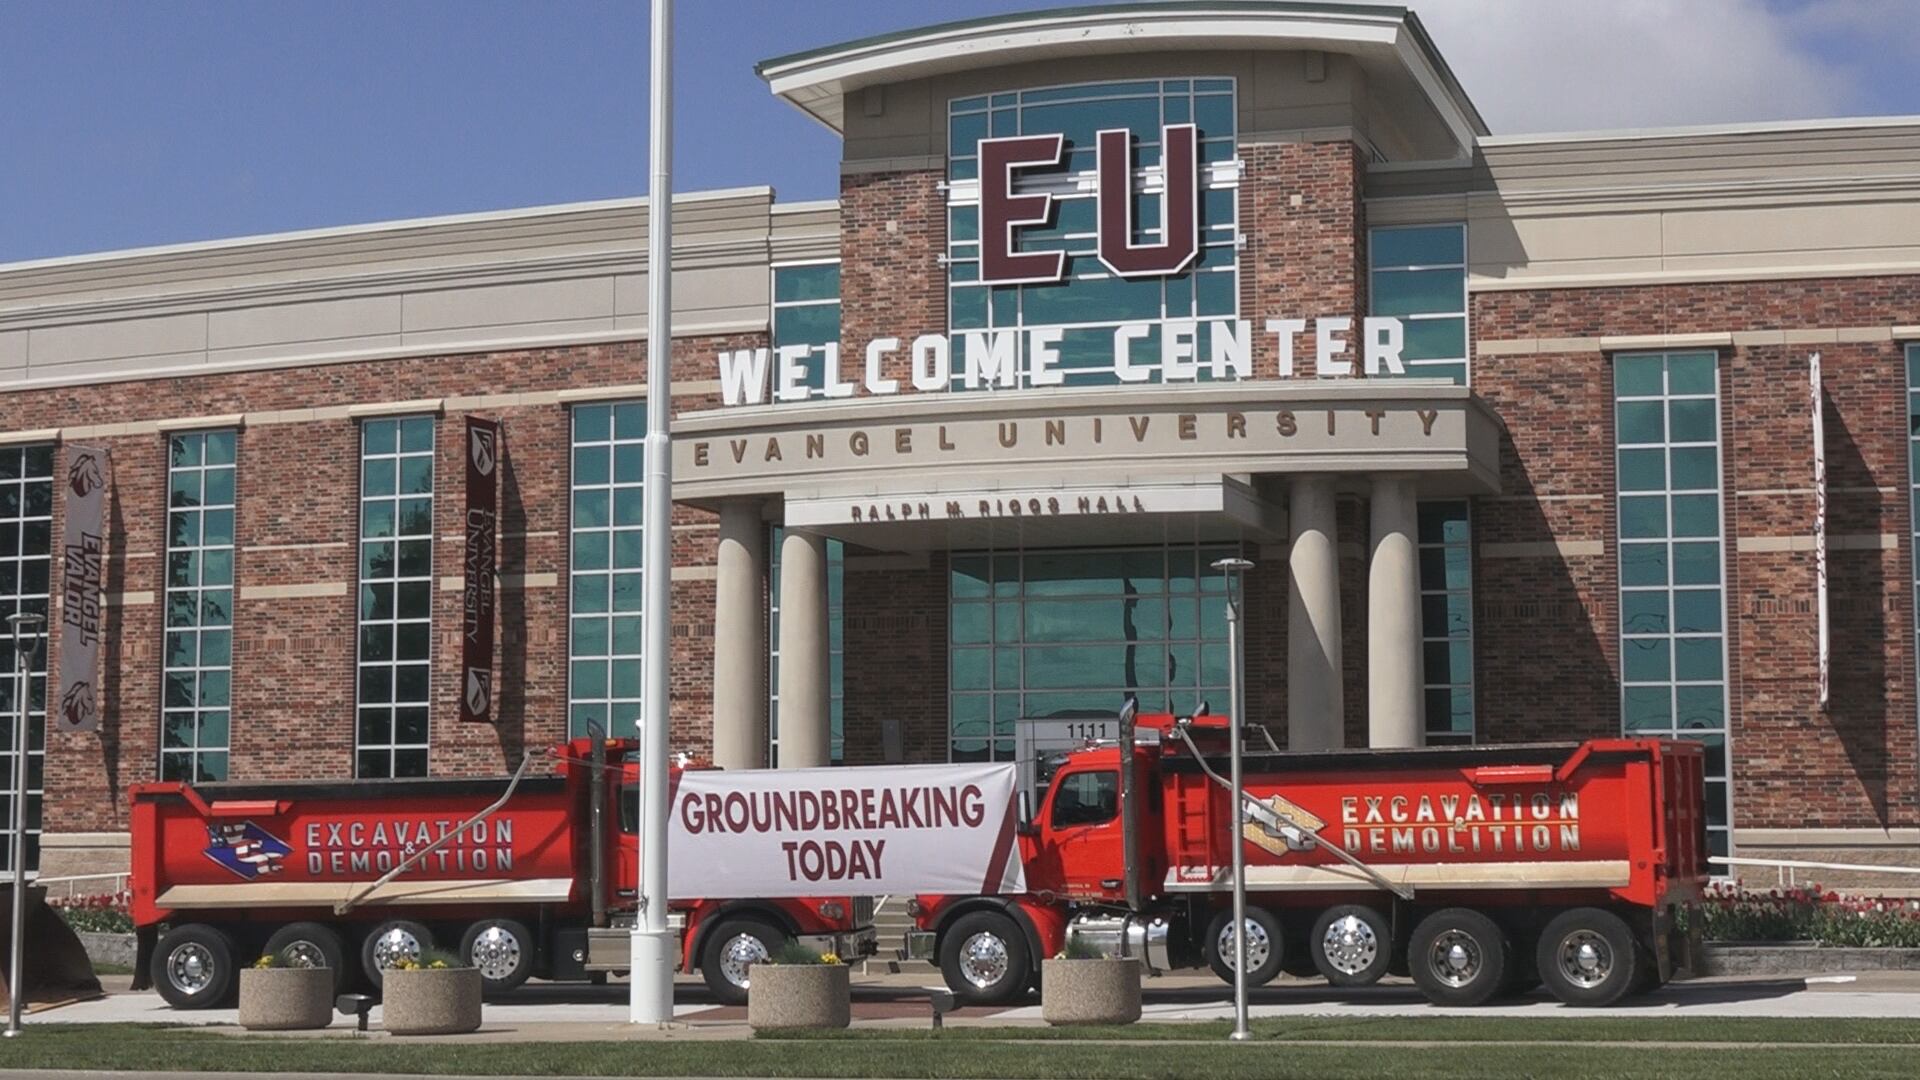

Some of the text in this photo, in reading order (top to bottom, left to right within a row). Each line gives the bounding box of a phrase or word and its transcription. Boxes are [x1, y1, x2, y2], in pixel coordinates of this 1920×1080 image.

[978, 123, 1198, 285] EU
[718, 317, 1405, 405] WELCOME CENTER
[694, 410, 1438, 466] EVANGEL UNIVERSITY
[1078, 495, 1145, 514] HALL
[63, 544, 85, 629] VALOR
[80, 532, 102, 647] EVANGEL
[466, 508, 484, 644] UNIVERSITY
[1067, 723, 1106, 738] 1111
[681, 784, 985, 834] GROUNDBREAKING
[1341, 793, 1579, 823] EXCAVATION
[307, 819, 513, 846] EXCAVATION
[1343, 825, 1581, 852] DEMOLITION
[309, 848, 513, 874] DEMOLITION
[781, 839, 886, 881] TODAY
